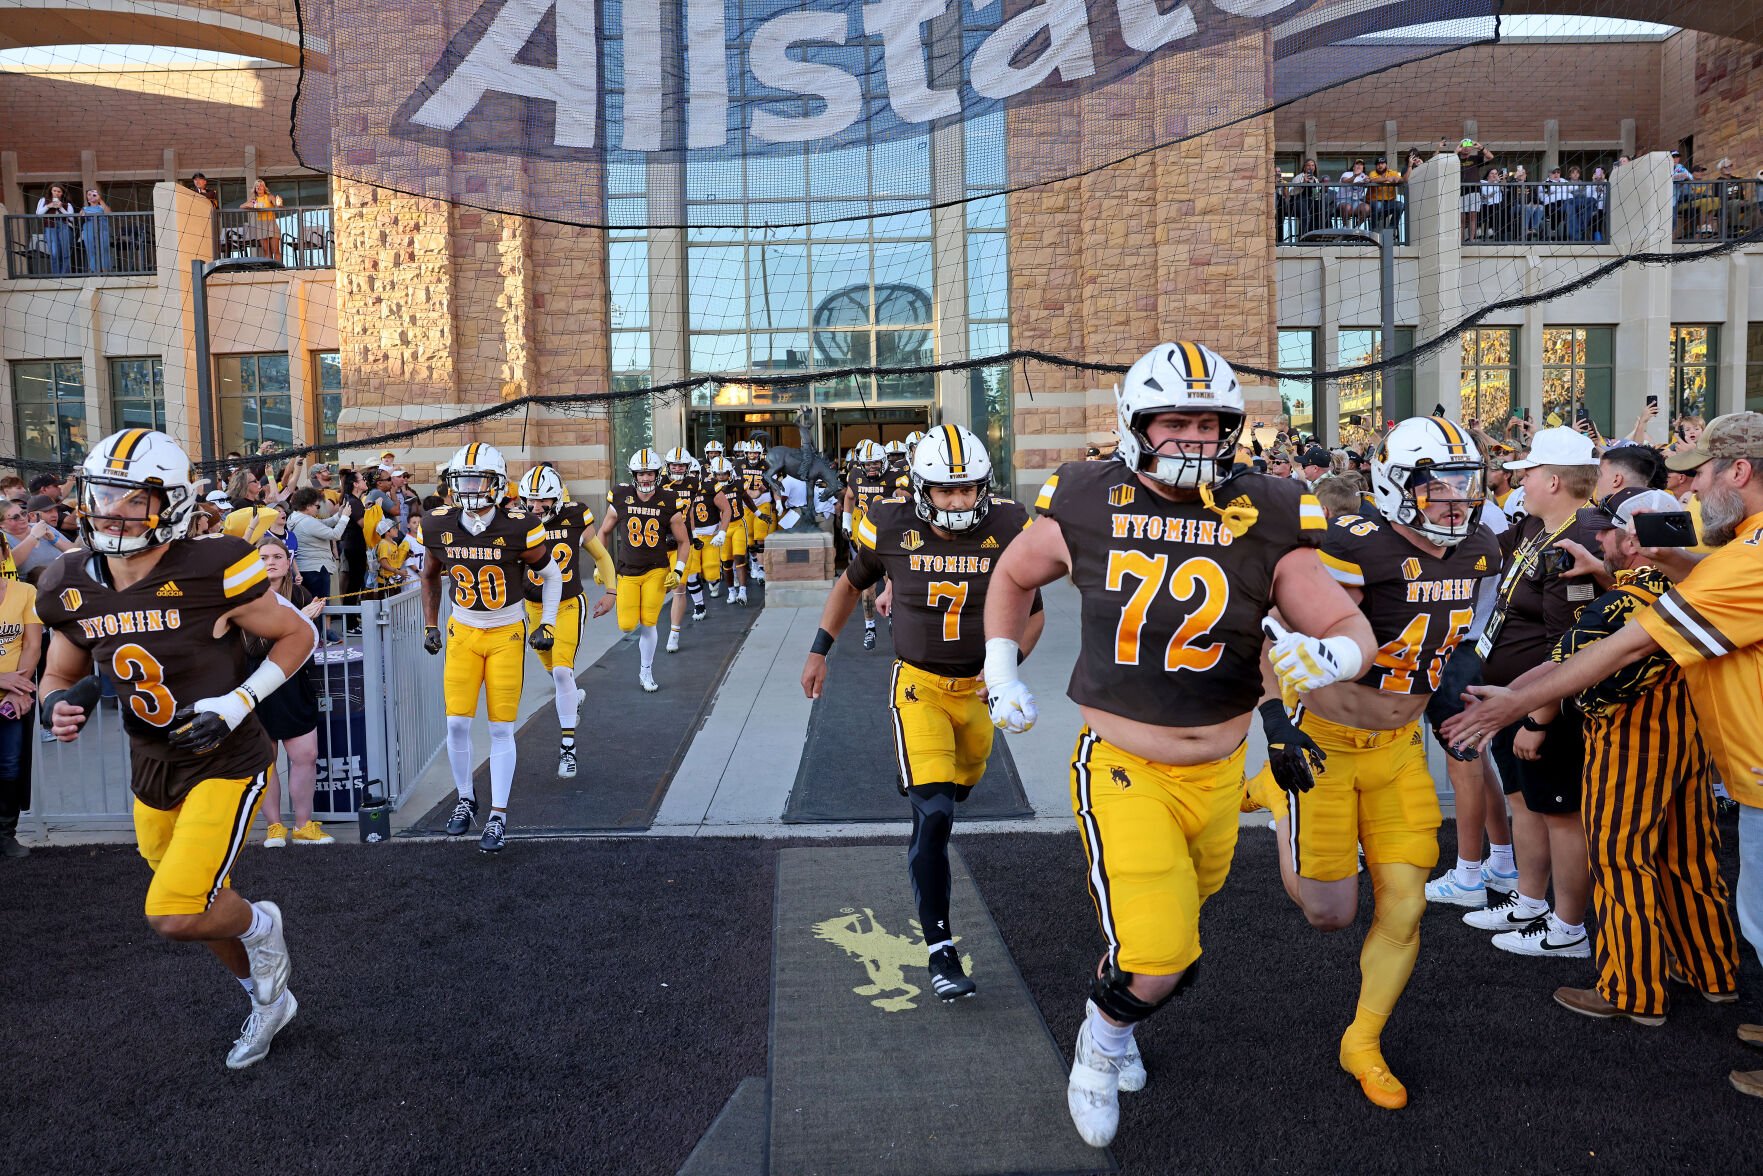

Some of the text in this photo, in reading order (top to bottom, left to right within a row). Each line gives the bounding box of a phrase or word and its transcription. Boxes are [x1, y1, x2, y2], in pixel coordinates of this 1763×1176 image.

[409, 0, 1296, 151] Allsta
[1186, 391, 1215, 399] WYOMING
[626, 516, 660, 548] 86
[1111, 513, 1234, 547] WYOMING
[444, 546, 502, 560] WYOMING
[910, 554, 991, 573] WYOMING
[156, 589, 184, 597] adidas
[450, 564, 507, 610] 30
[1406, 578, 1477, 603] WYOMIN
[77, 609, 181, 639] WYOMING
[926, 580, 968, 641] 7
[1105, 549, 1230, 672] 72
[1373, 605, 1475, 694] 45
[112, 643, 178, 728] 3
